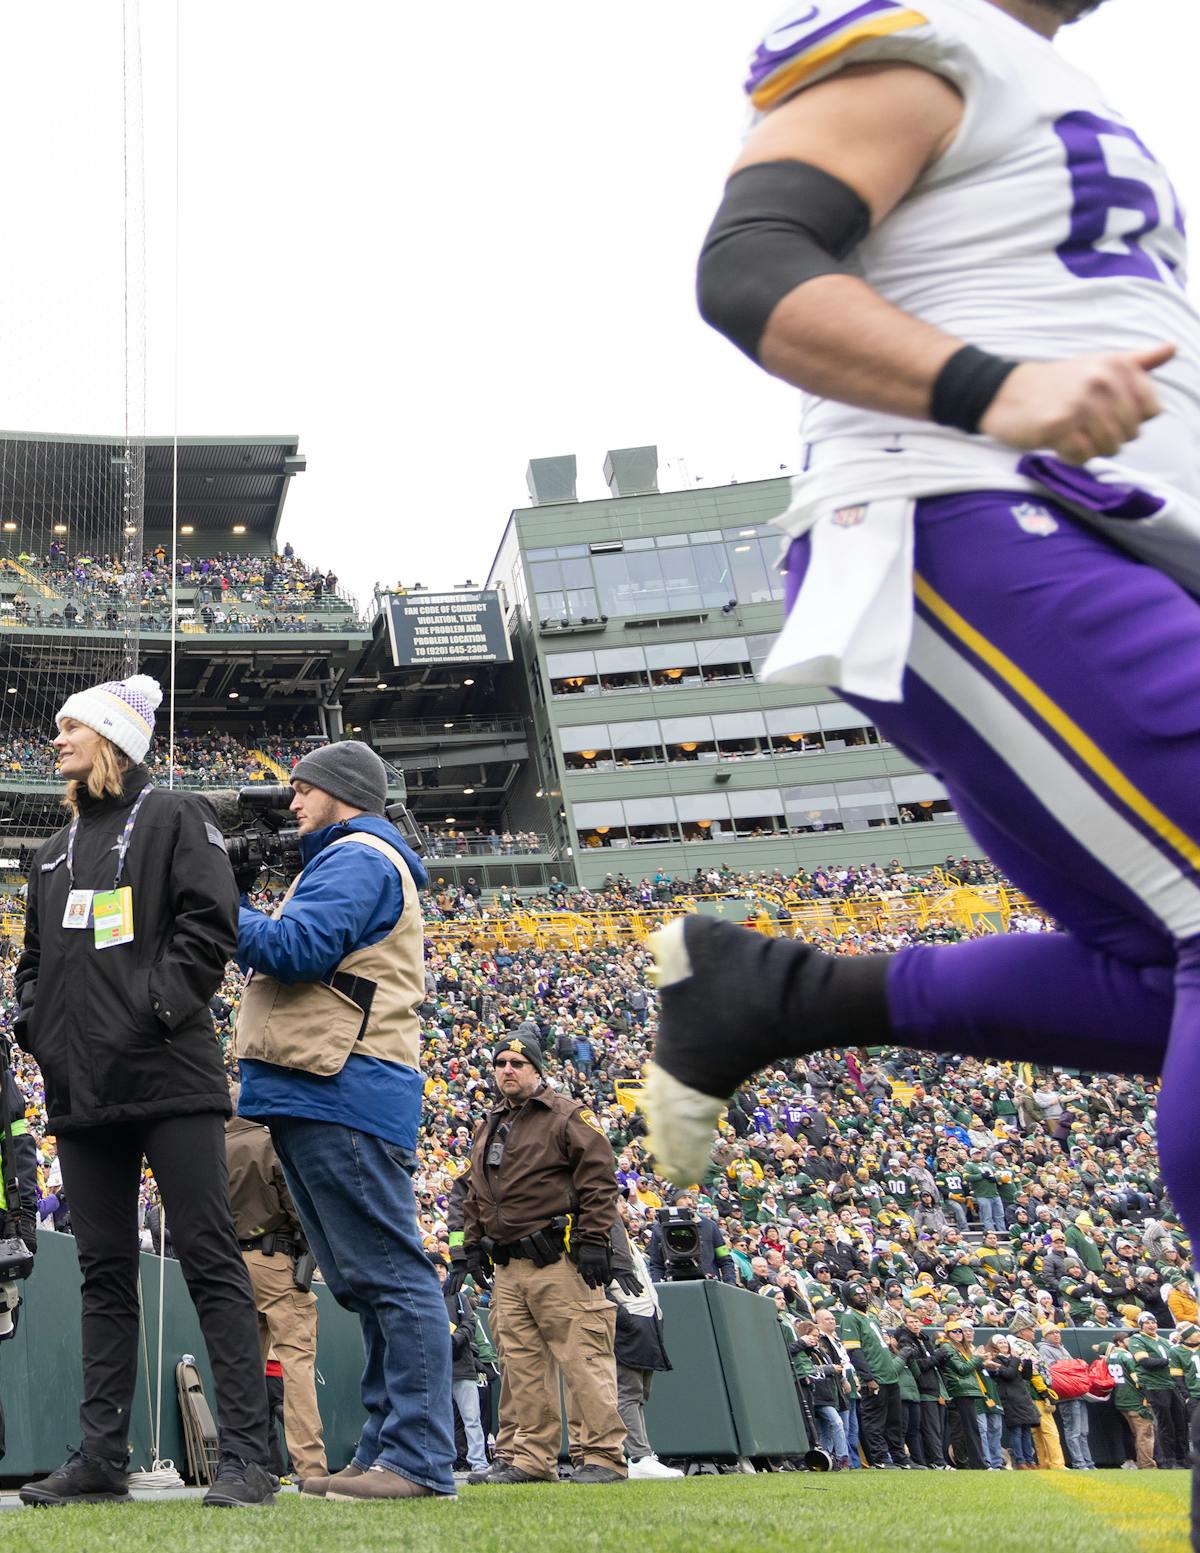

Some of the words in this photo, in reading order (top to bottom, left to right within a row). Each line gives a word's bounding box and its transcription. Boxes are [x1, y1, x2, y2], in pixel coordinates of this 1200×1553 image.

[404, 607, 419, 616] FAN
[419, 606, 440, 615] CODE
[440, 605, 450, 614] OF
[451, 603, 487, 613] CONDUCT
[417, 615, 459, 625] VIOLATION,
[459, 614, 477, 623] TEXT
[414, 627, 430, 635] THE
[430, 625, 465, 635] PROBLEM
[466, 624, 482, 632] AND
[413, 636, 449, 646] PROBLEM
[450, 634, 487, 644] LOCATION
[415, 648, 426, 656] TO
[449, 644, 488, 654] 645-2300
[889, 1180, 906, 1194] 00
[945, 1176, 962, 1190] 87
